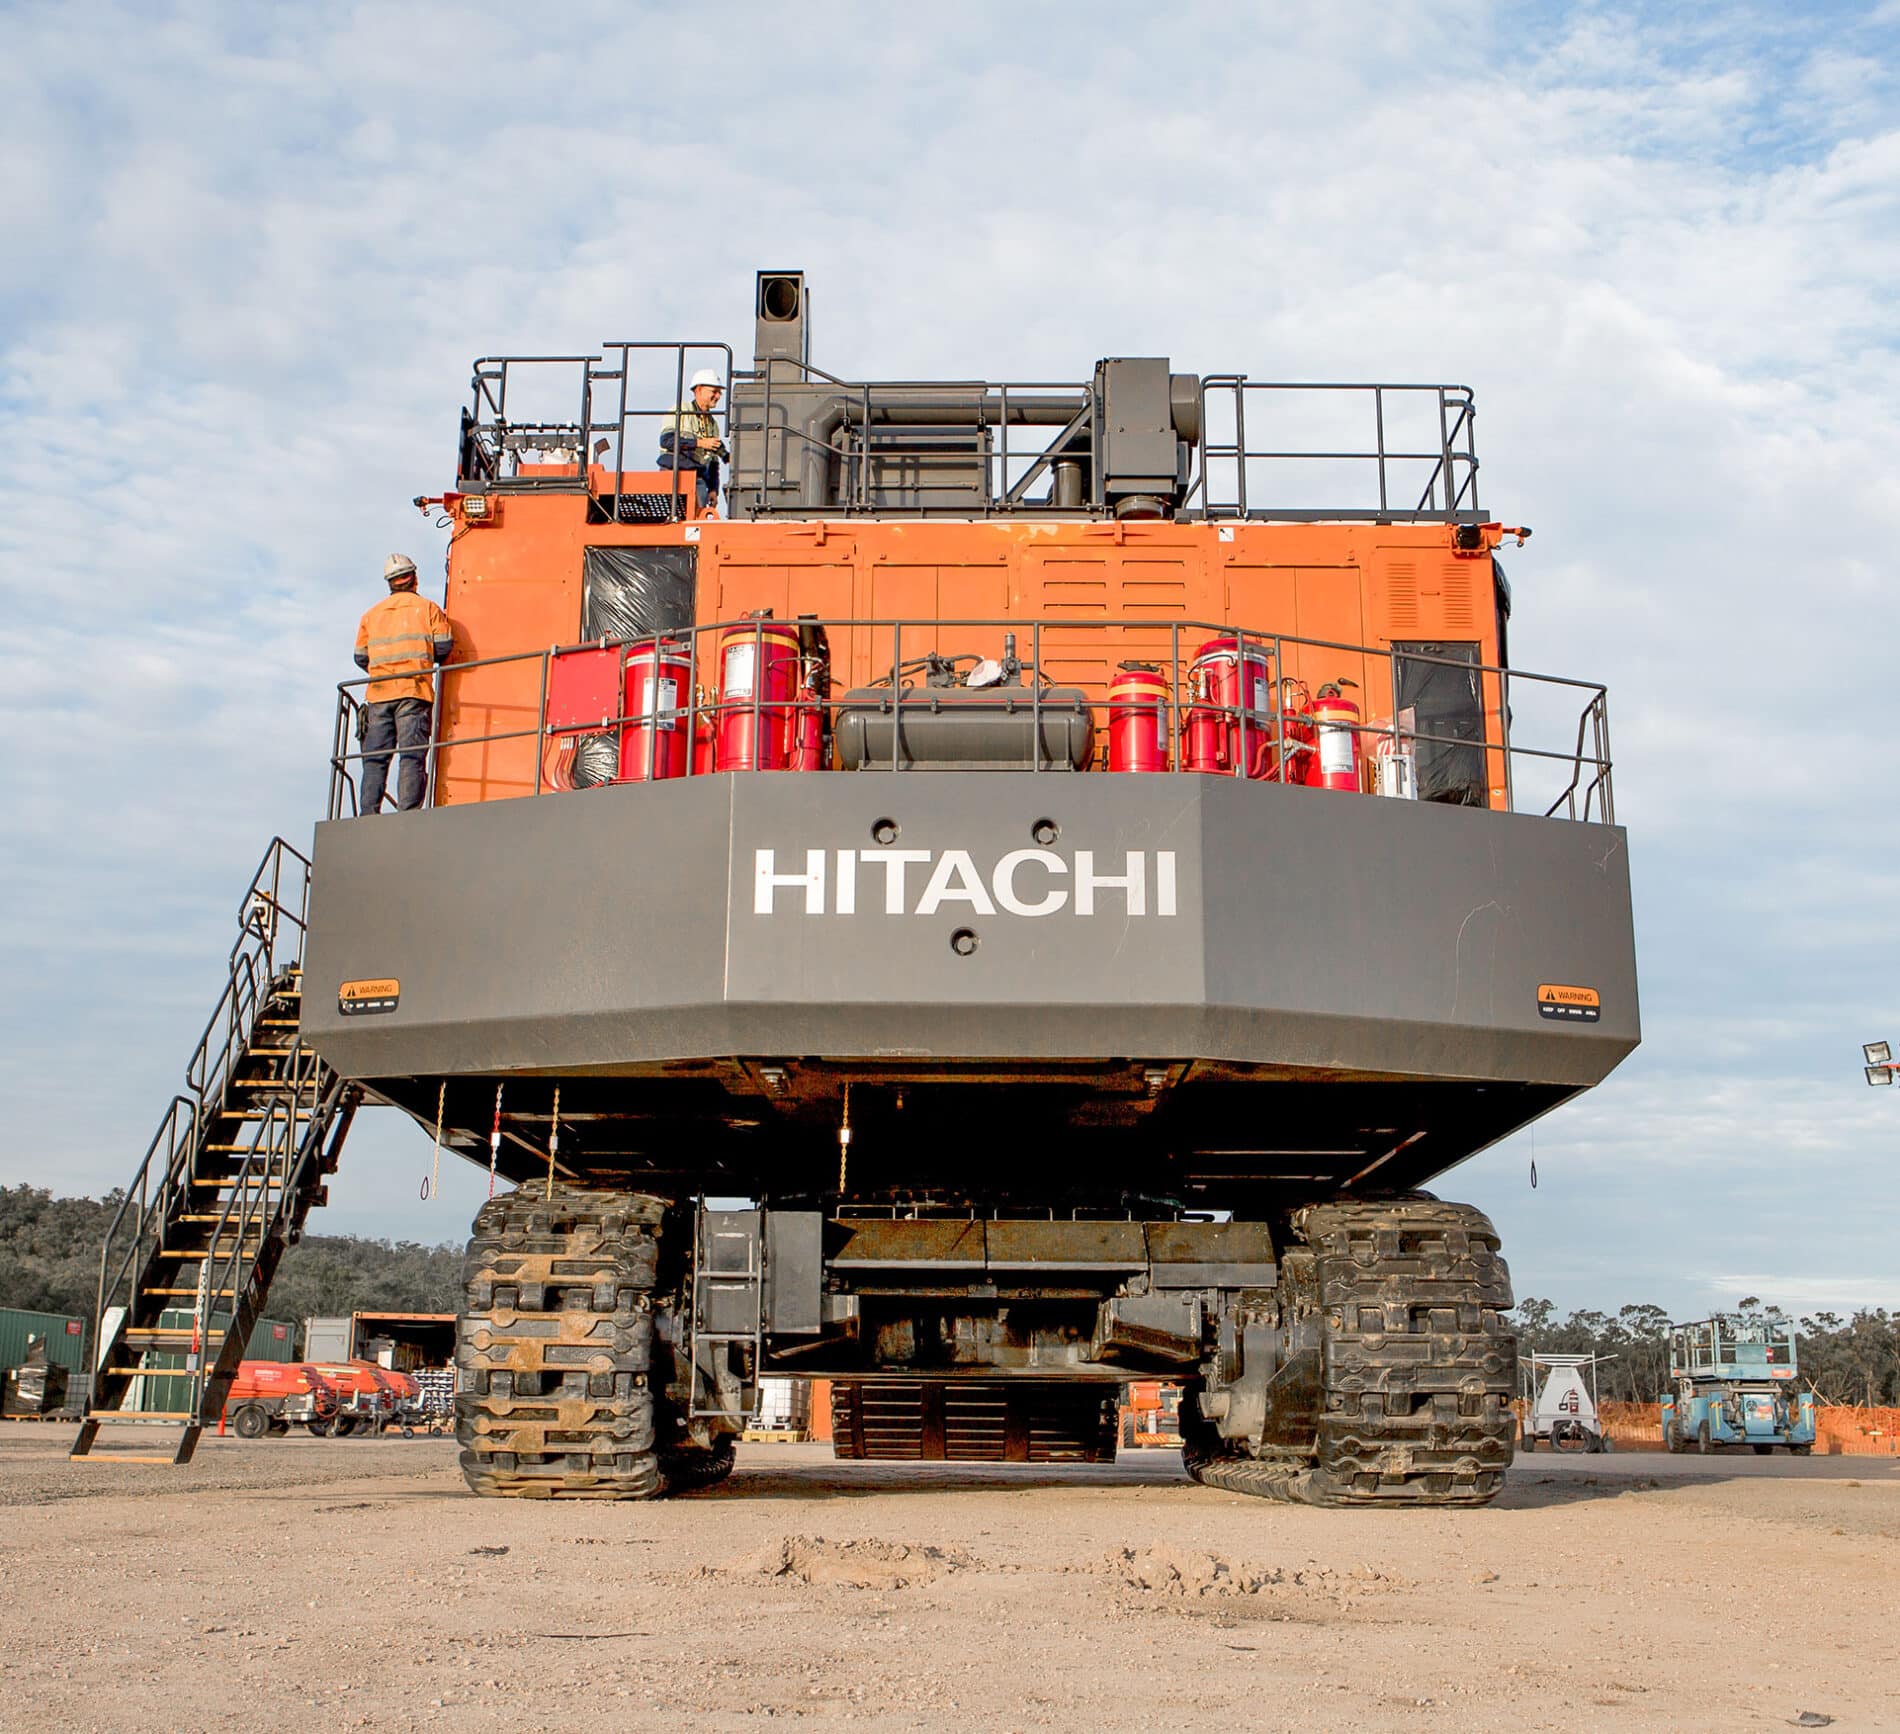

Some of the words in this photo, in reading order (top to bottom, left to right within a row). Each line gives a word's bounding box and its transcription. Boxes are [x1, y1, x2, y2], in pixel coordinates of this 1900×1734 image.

[754, 849, 1176, 916] HITACHI
[360, 985, 392, 993] WARNING
[1558, 992, 1592, 1001] WARNING
